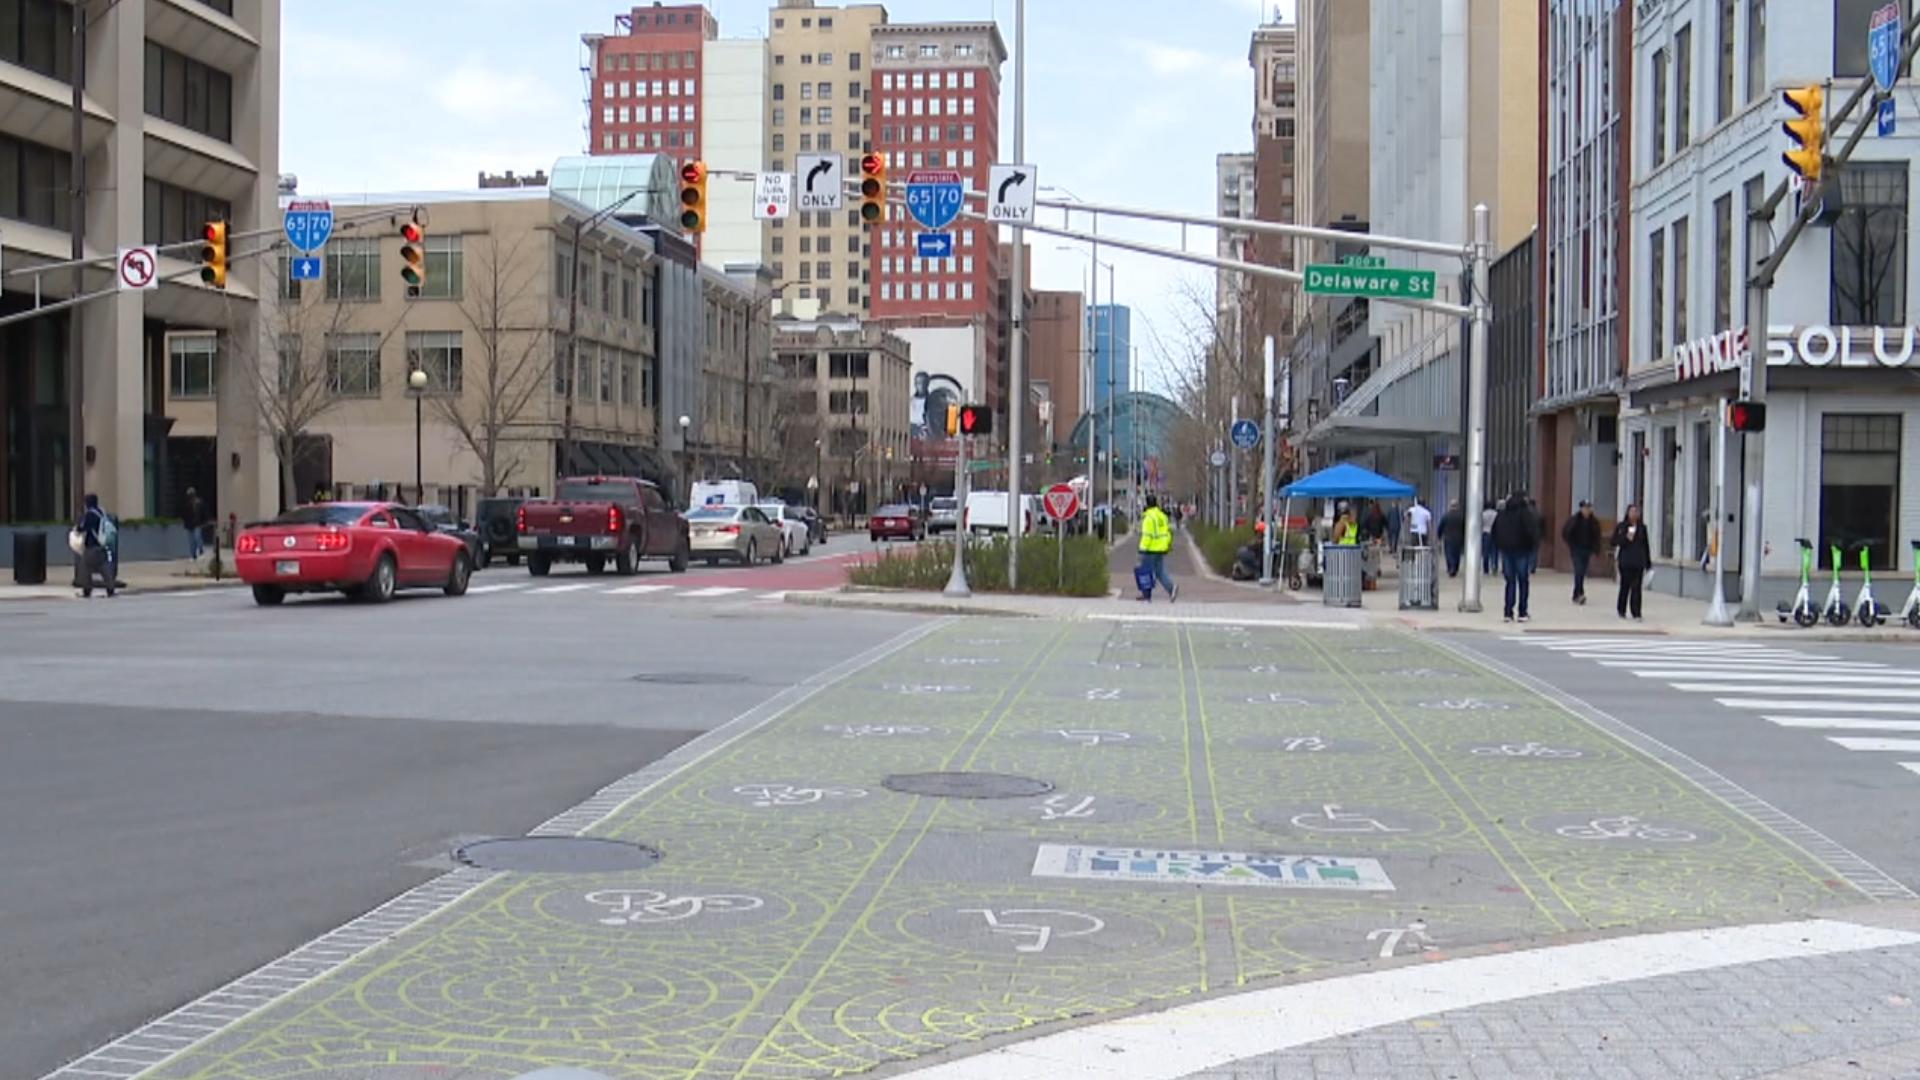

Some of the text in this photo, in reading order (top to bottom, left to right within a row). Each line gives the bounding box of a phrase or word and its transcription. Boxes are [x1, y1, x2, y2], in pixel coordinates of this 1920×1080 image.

[765, 175, 782, 184] NO
[763, 186, 784, 194] TURN
[908, 188, 959, 204] 65 70
[757, 195, 788, 204] ON RED
[802, 194, 836, 206] ONLY
[993, 204, 1028, 218] ONLY
[287, 216, 329, 231] 65 70
[1348, 256, 1370, 267] 200
[1309, 271, 1430, 292] Delaware St
